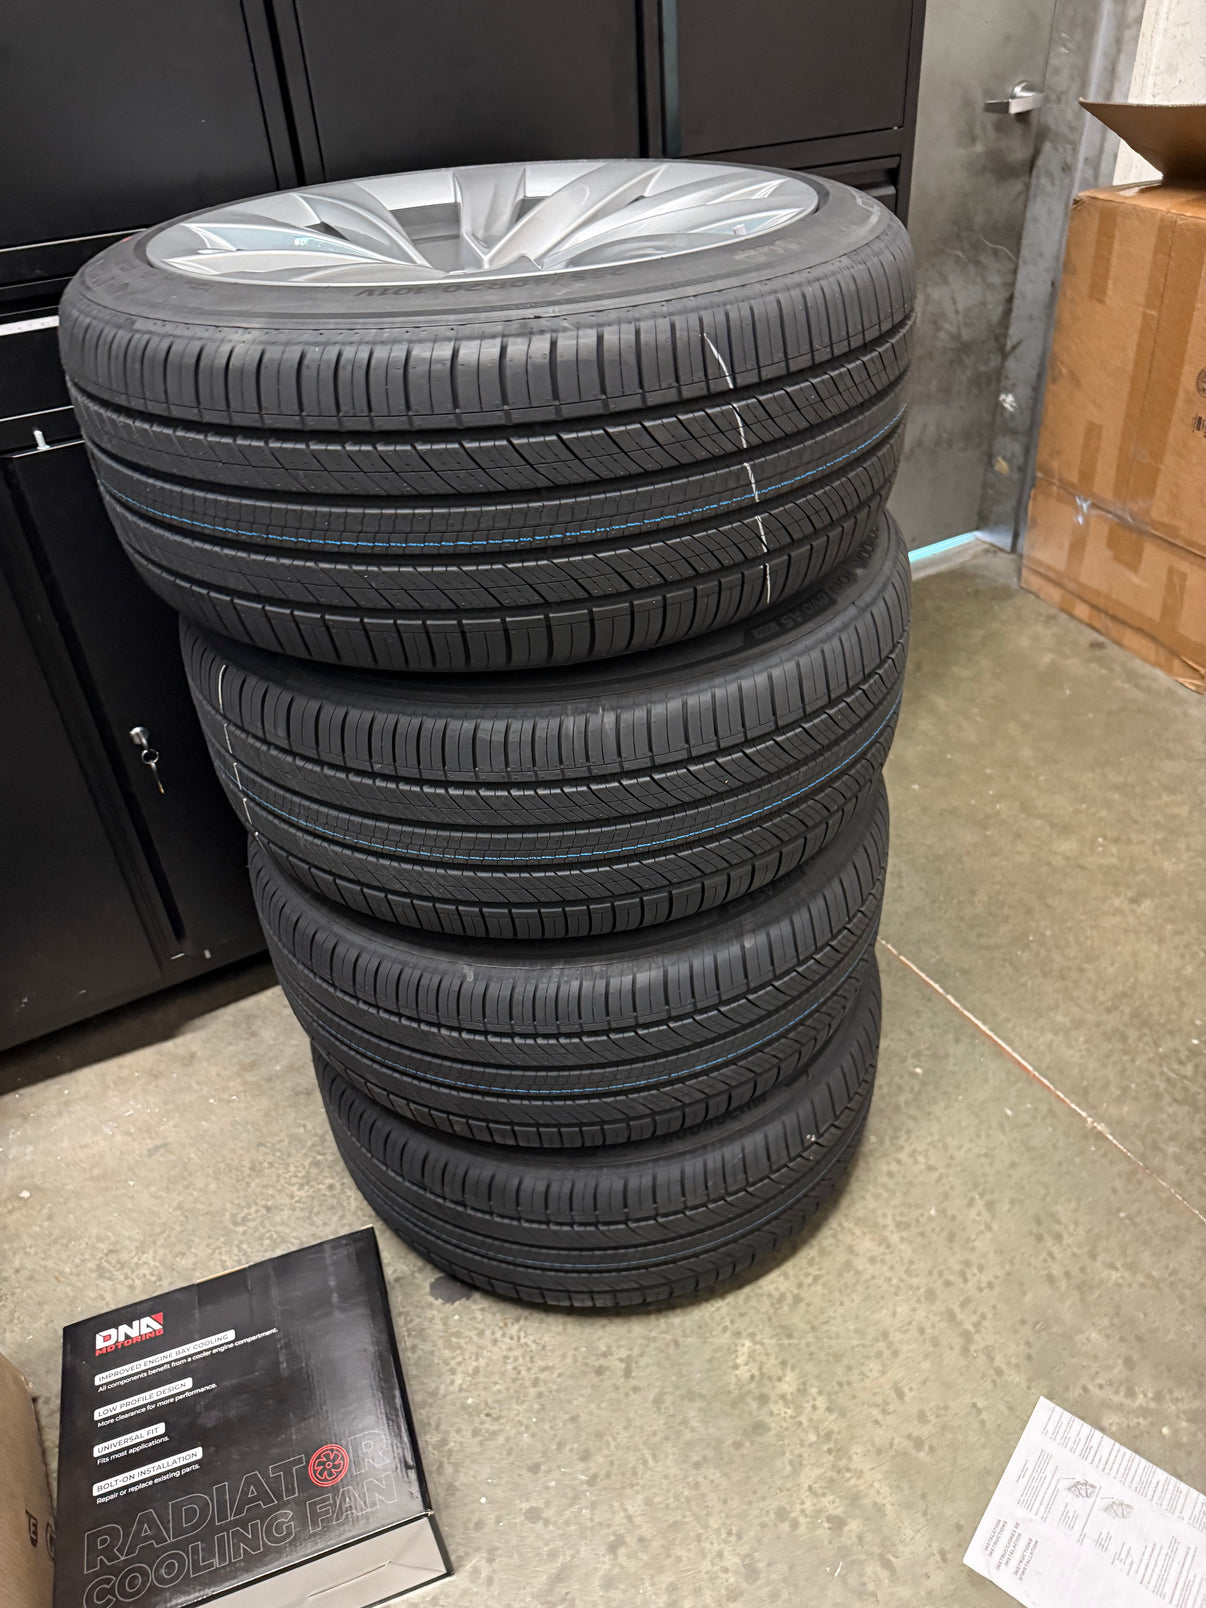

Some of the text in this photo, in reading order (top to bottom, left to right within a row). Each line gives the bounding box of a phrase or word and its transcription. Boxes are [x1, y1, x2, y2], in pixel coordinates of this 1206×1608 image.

[780, 603, 804, 630] AS
[95, 1312, 164, 1351] DNA
[95, 1328, 164, 1357] MOTORING
[97, 1385, 107, 1393] All
[107, 1371, 148, 1389] components
[148, 1364, 171, 1377] benefit
[171, 1358, 187, 1368] from
[192, 1349, 212, 1361] cooler
[212, 1342, 234, 1354] engine
[234, 1327, 279, 1346] compartment.
[98, 1333, 229, 1383] IMPROVED ENGINE BAY COOLING
[97, 1381, 187, 1418] LOW PROFILE DESIGN
[97, 1383, 218, 1428] More clearance for more performance.
[97, 1426, 160, 1454] UNIVERSAL FIT
[97, 1435, 170, 1465] Fits most applications.
[96, 1451, 198, 1493] BOLT-ON INSTALLATION
[96, 1462, 201, 1505] Repair or replace existing parts.
[83, 1471, 398, 1608] COOLING FAN
[988, 1519, 1008, 1558] INSTRUCTIONS
[1014, 1537, 1033, 1576] INSTRUCTIONS
